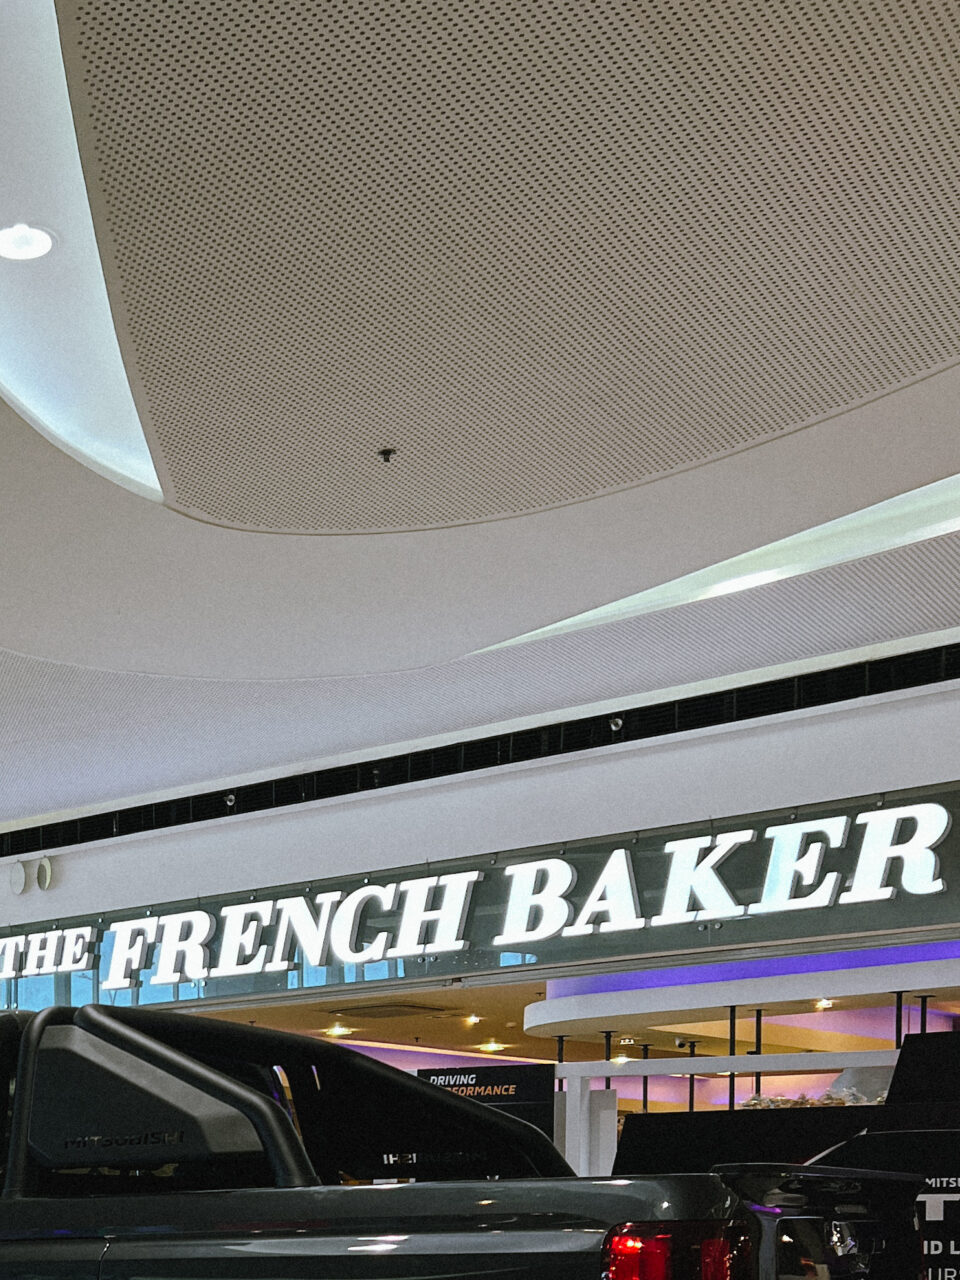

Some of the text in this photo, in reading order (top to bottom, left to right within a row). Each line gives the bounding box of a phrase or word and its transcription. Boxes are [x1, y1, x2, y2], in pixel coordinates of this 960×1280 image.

[102, 870, 482, 990] FRENCH
[493, 802, 951, 946] BAKER
[430, 1074, 476, 1086] DRIVING
[444, 1085, 516, 1097] FORMANCE
